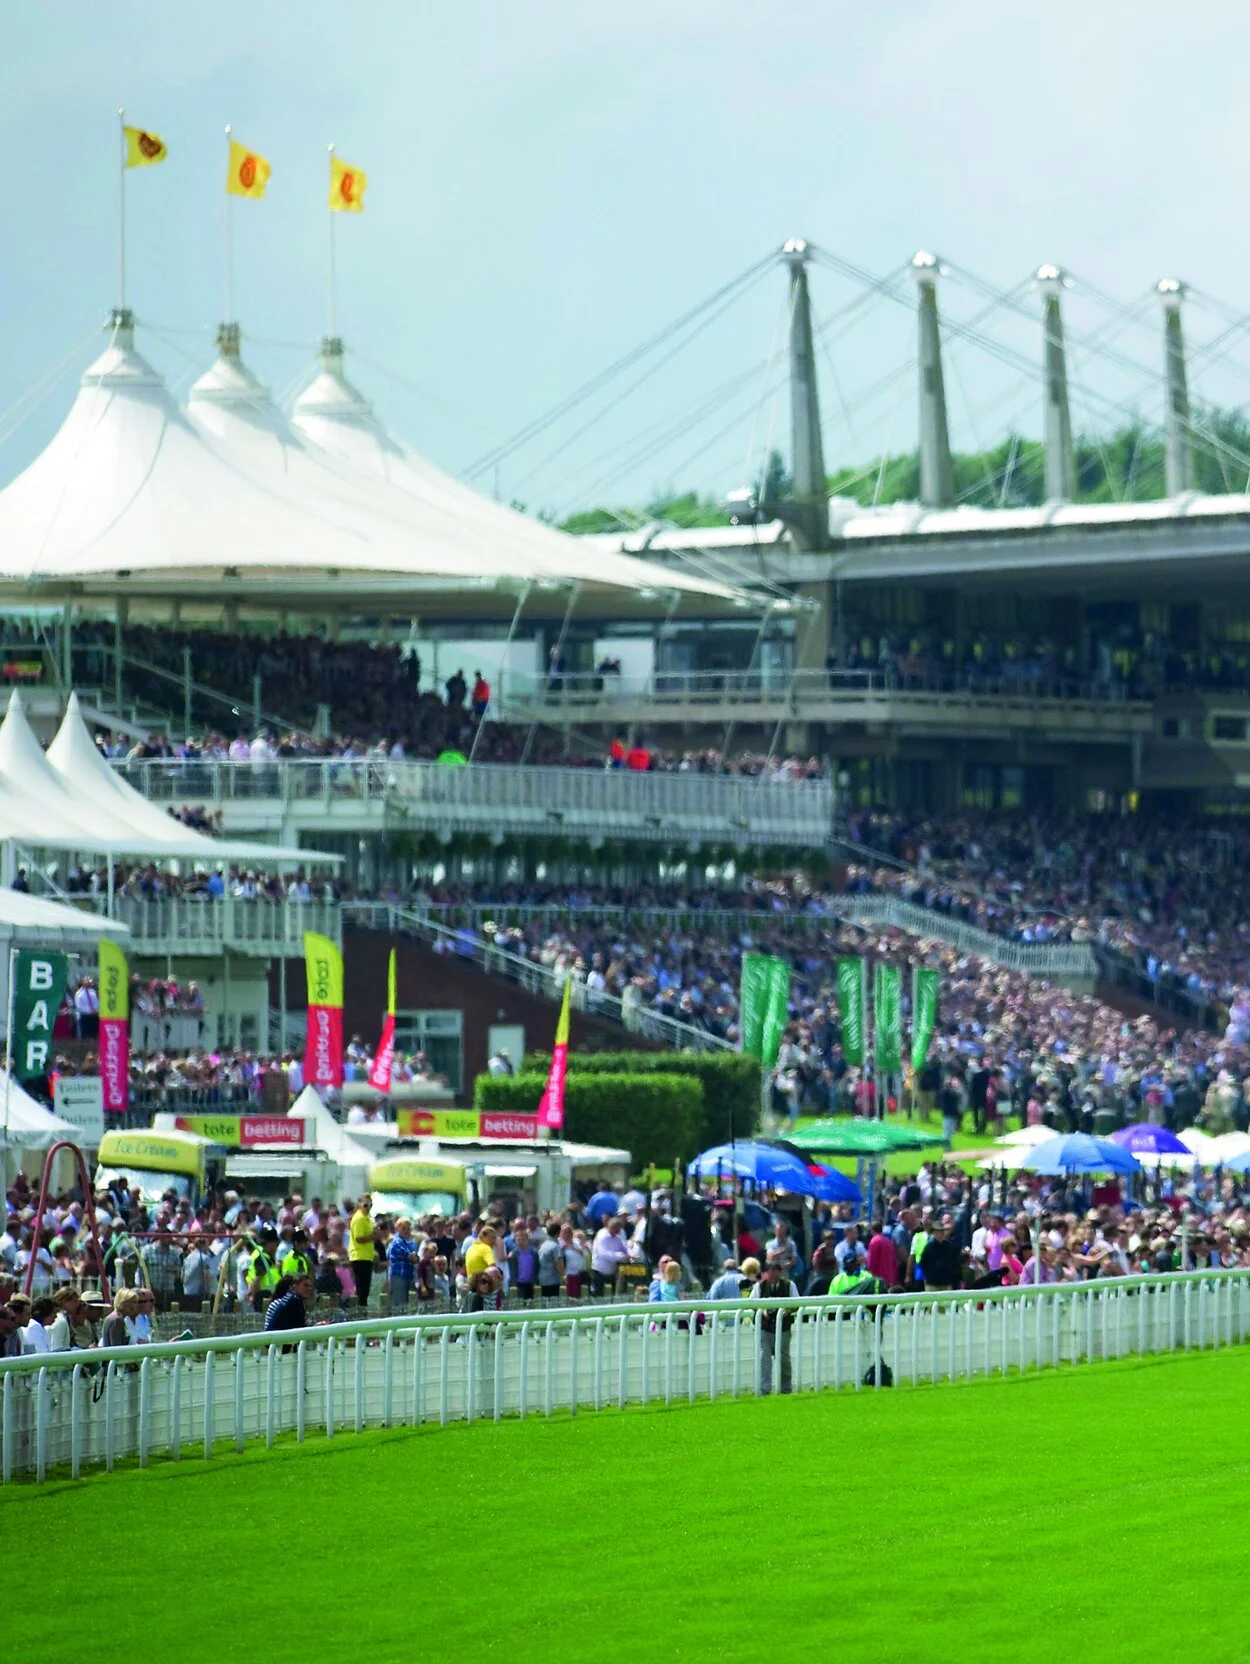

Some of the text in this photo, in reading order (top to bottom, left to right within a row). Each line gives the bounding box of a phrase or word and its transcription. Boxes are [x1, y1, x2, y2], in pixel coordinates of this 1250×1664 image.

[26, 960, 53, 1070] BAR
[203, 1122, 235, 1136] tote
[244, 1122, 300, 1139] betting
[445, 1118, 476, 1132] tote
[484, 1119, 534, 1136] betting
